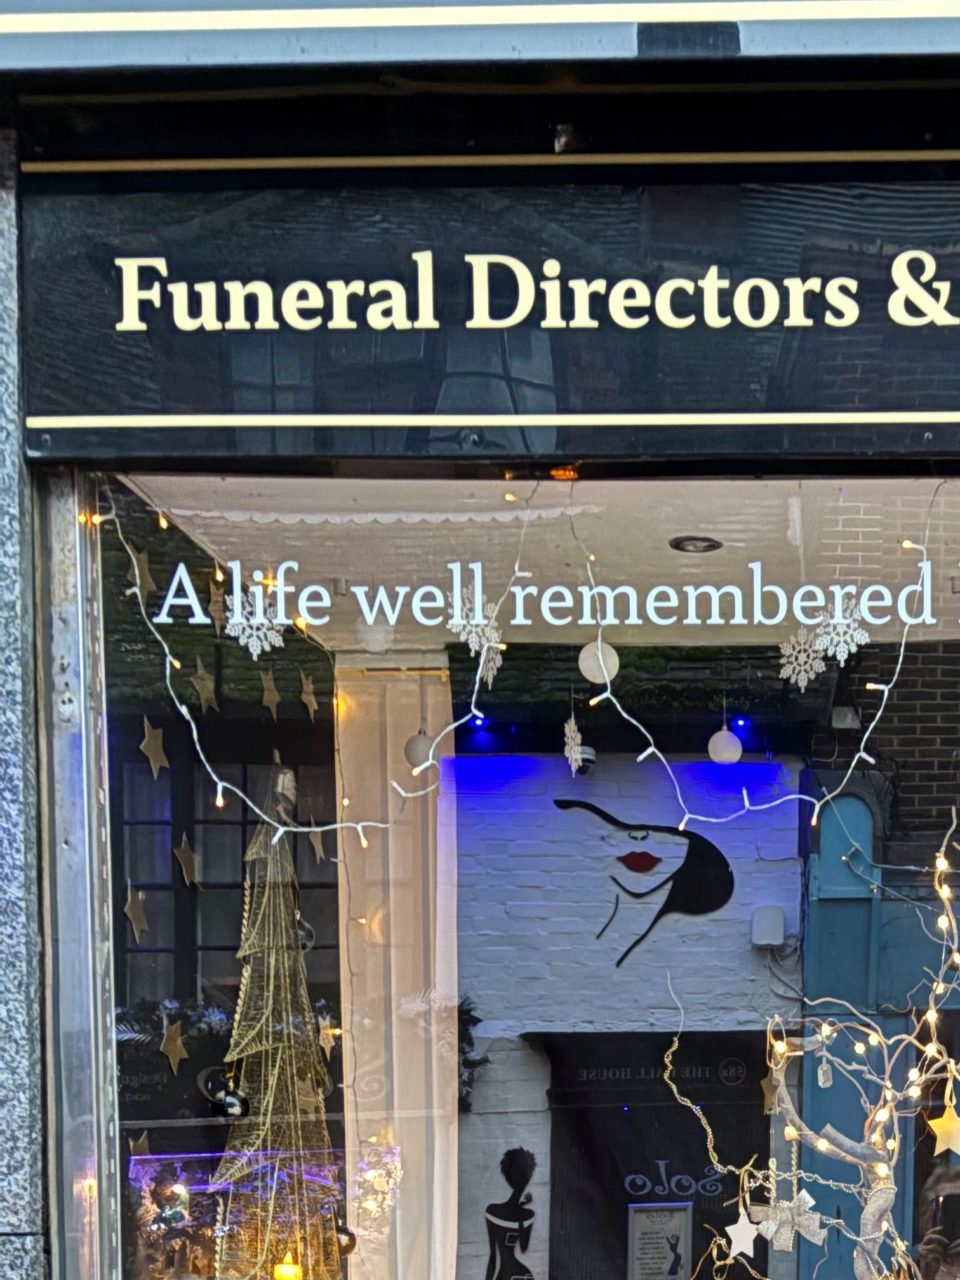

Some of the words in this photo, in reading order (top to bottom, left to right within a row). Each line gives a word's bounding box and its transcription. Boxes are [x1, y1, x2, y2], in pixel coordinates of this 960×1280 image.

[114, 251, 439, 331] Funeral
[465, 253, 860, 330] Directors
[152, 562, 210, 625] A
[227, 560, 331, 625] life
[350, 562, 488, 626] well
[510, 561, 933, 626] remembered
